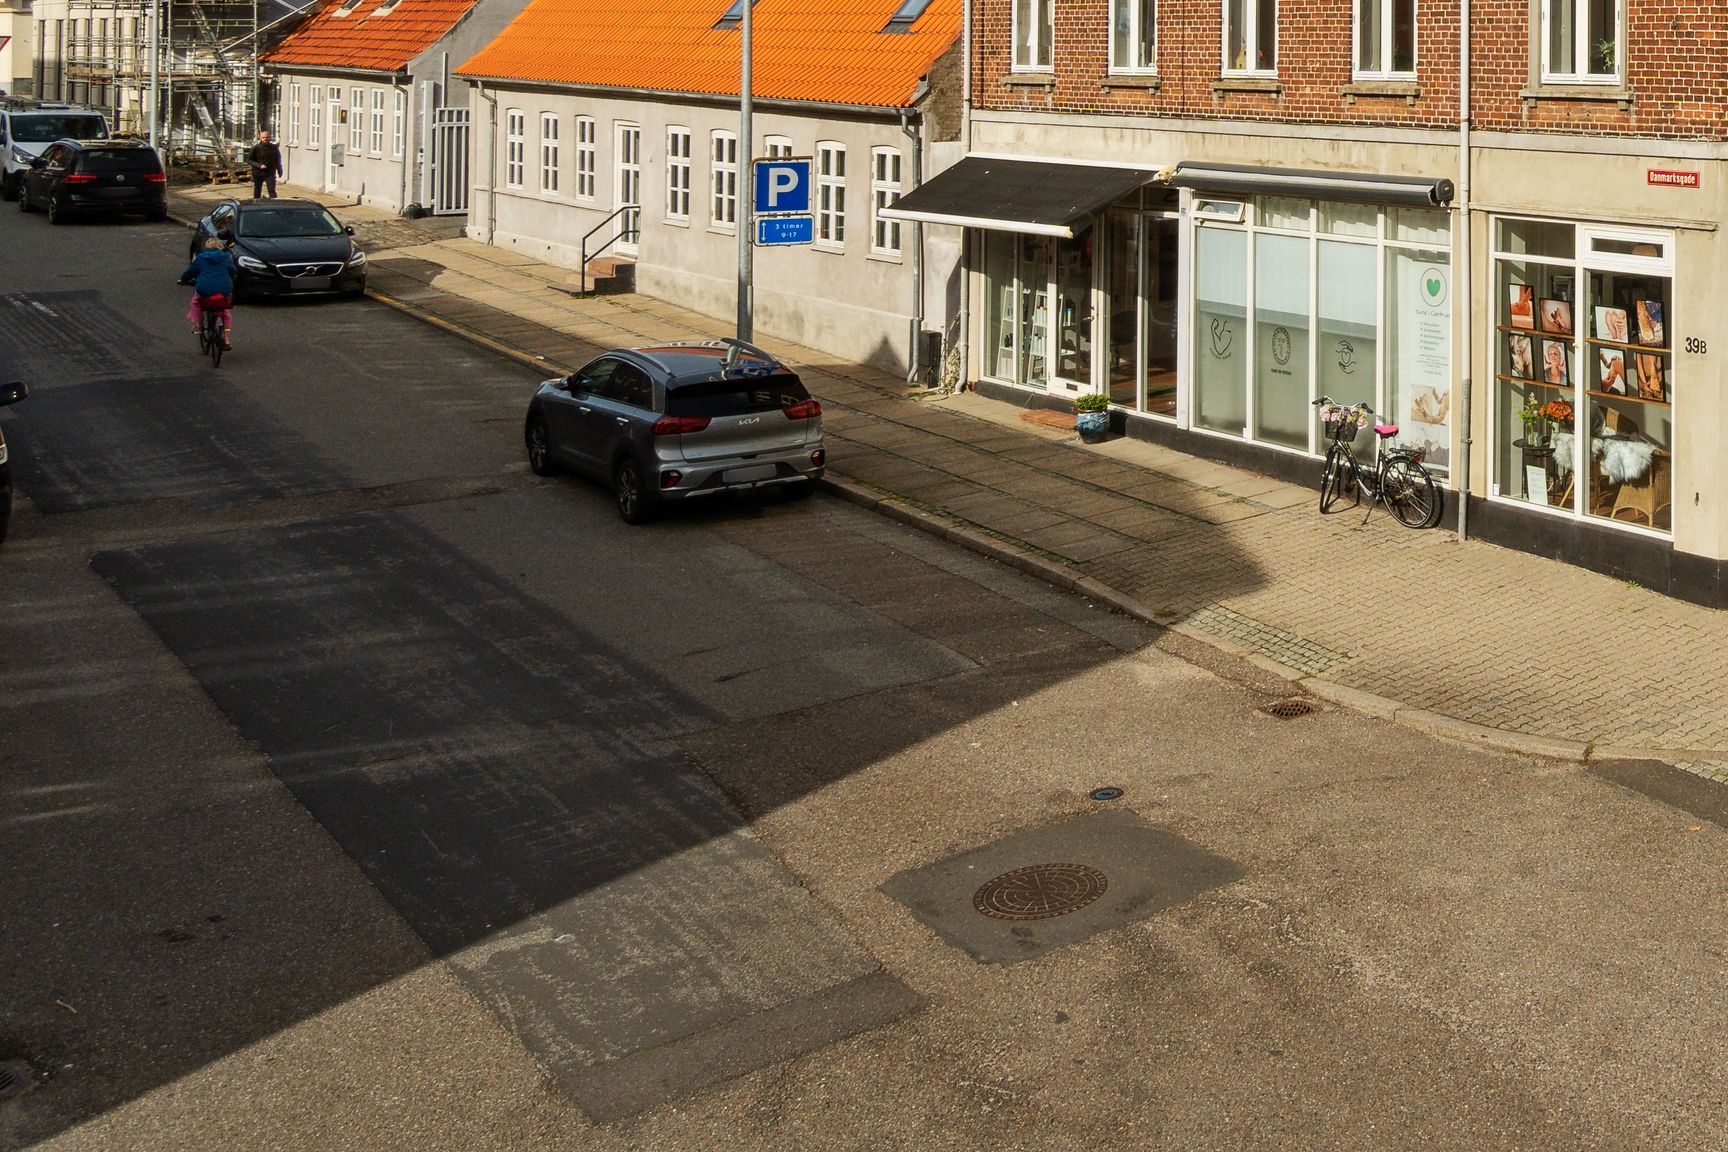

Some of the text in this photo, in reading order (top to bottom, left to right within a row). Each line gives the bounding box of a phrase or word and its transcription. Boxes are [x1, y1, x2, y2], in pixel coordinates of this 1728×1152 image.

[768, 167, 799, 207] P
[1650, 171, 1696, 186] Danmarksgade
[1685, 337, 1707, 354] 39B
